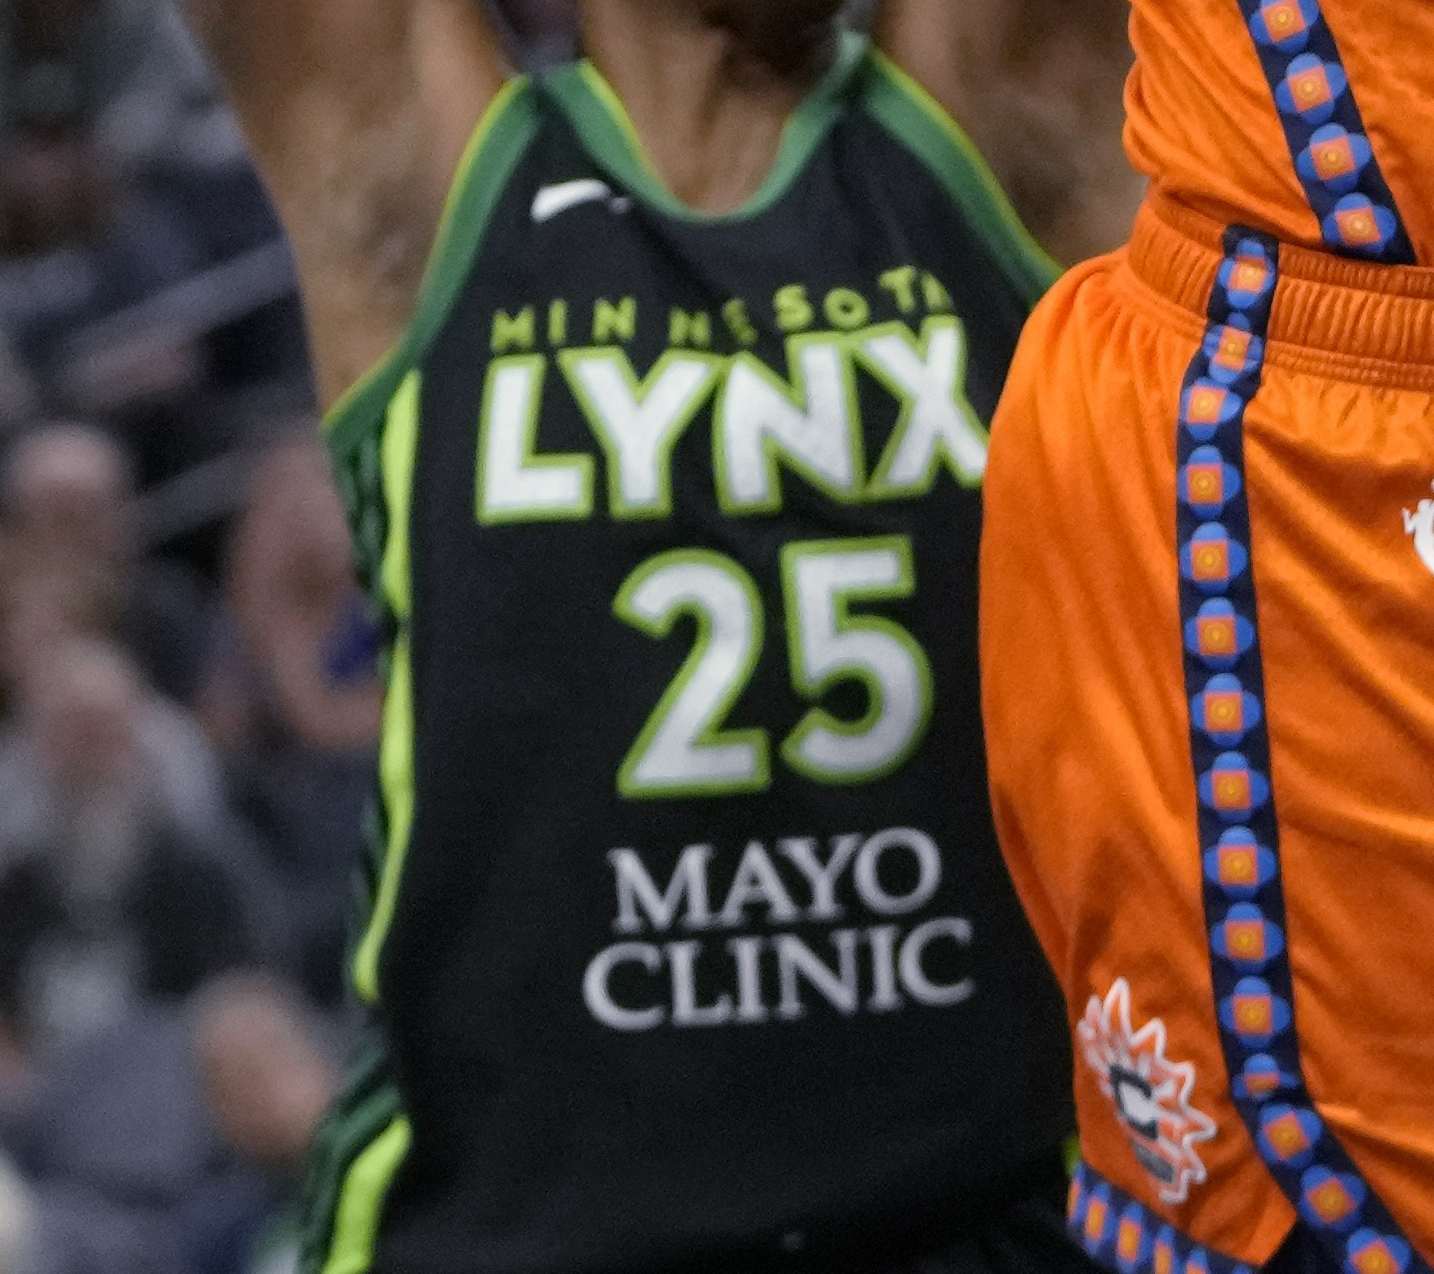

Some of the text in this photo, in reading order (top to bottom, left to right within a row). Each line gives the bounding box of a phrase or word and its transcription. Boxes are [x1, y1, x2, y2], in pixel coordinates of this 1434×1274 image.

[474, 314, 990, 527] LYNX
[612, 534, 935, 801] 25
[607, 826, 942, 935] MAYO
[582, 915, 973, 1033] CLINIC
